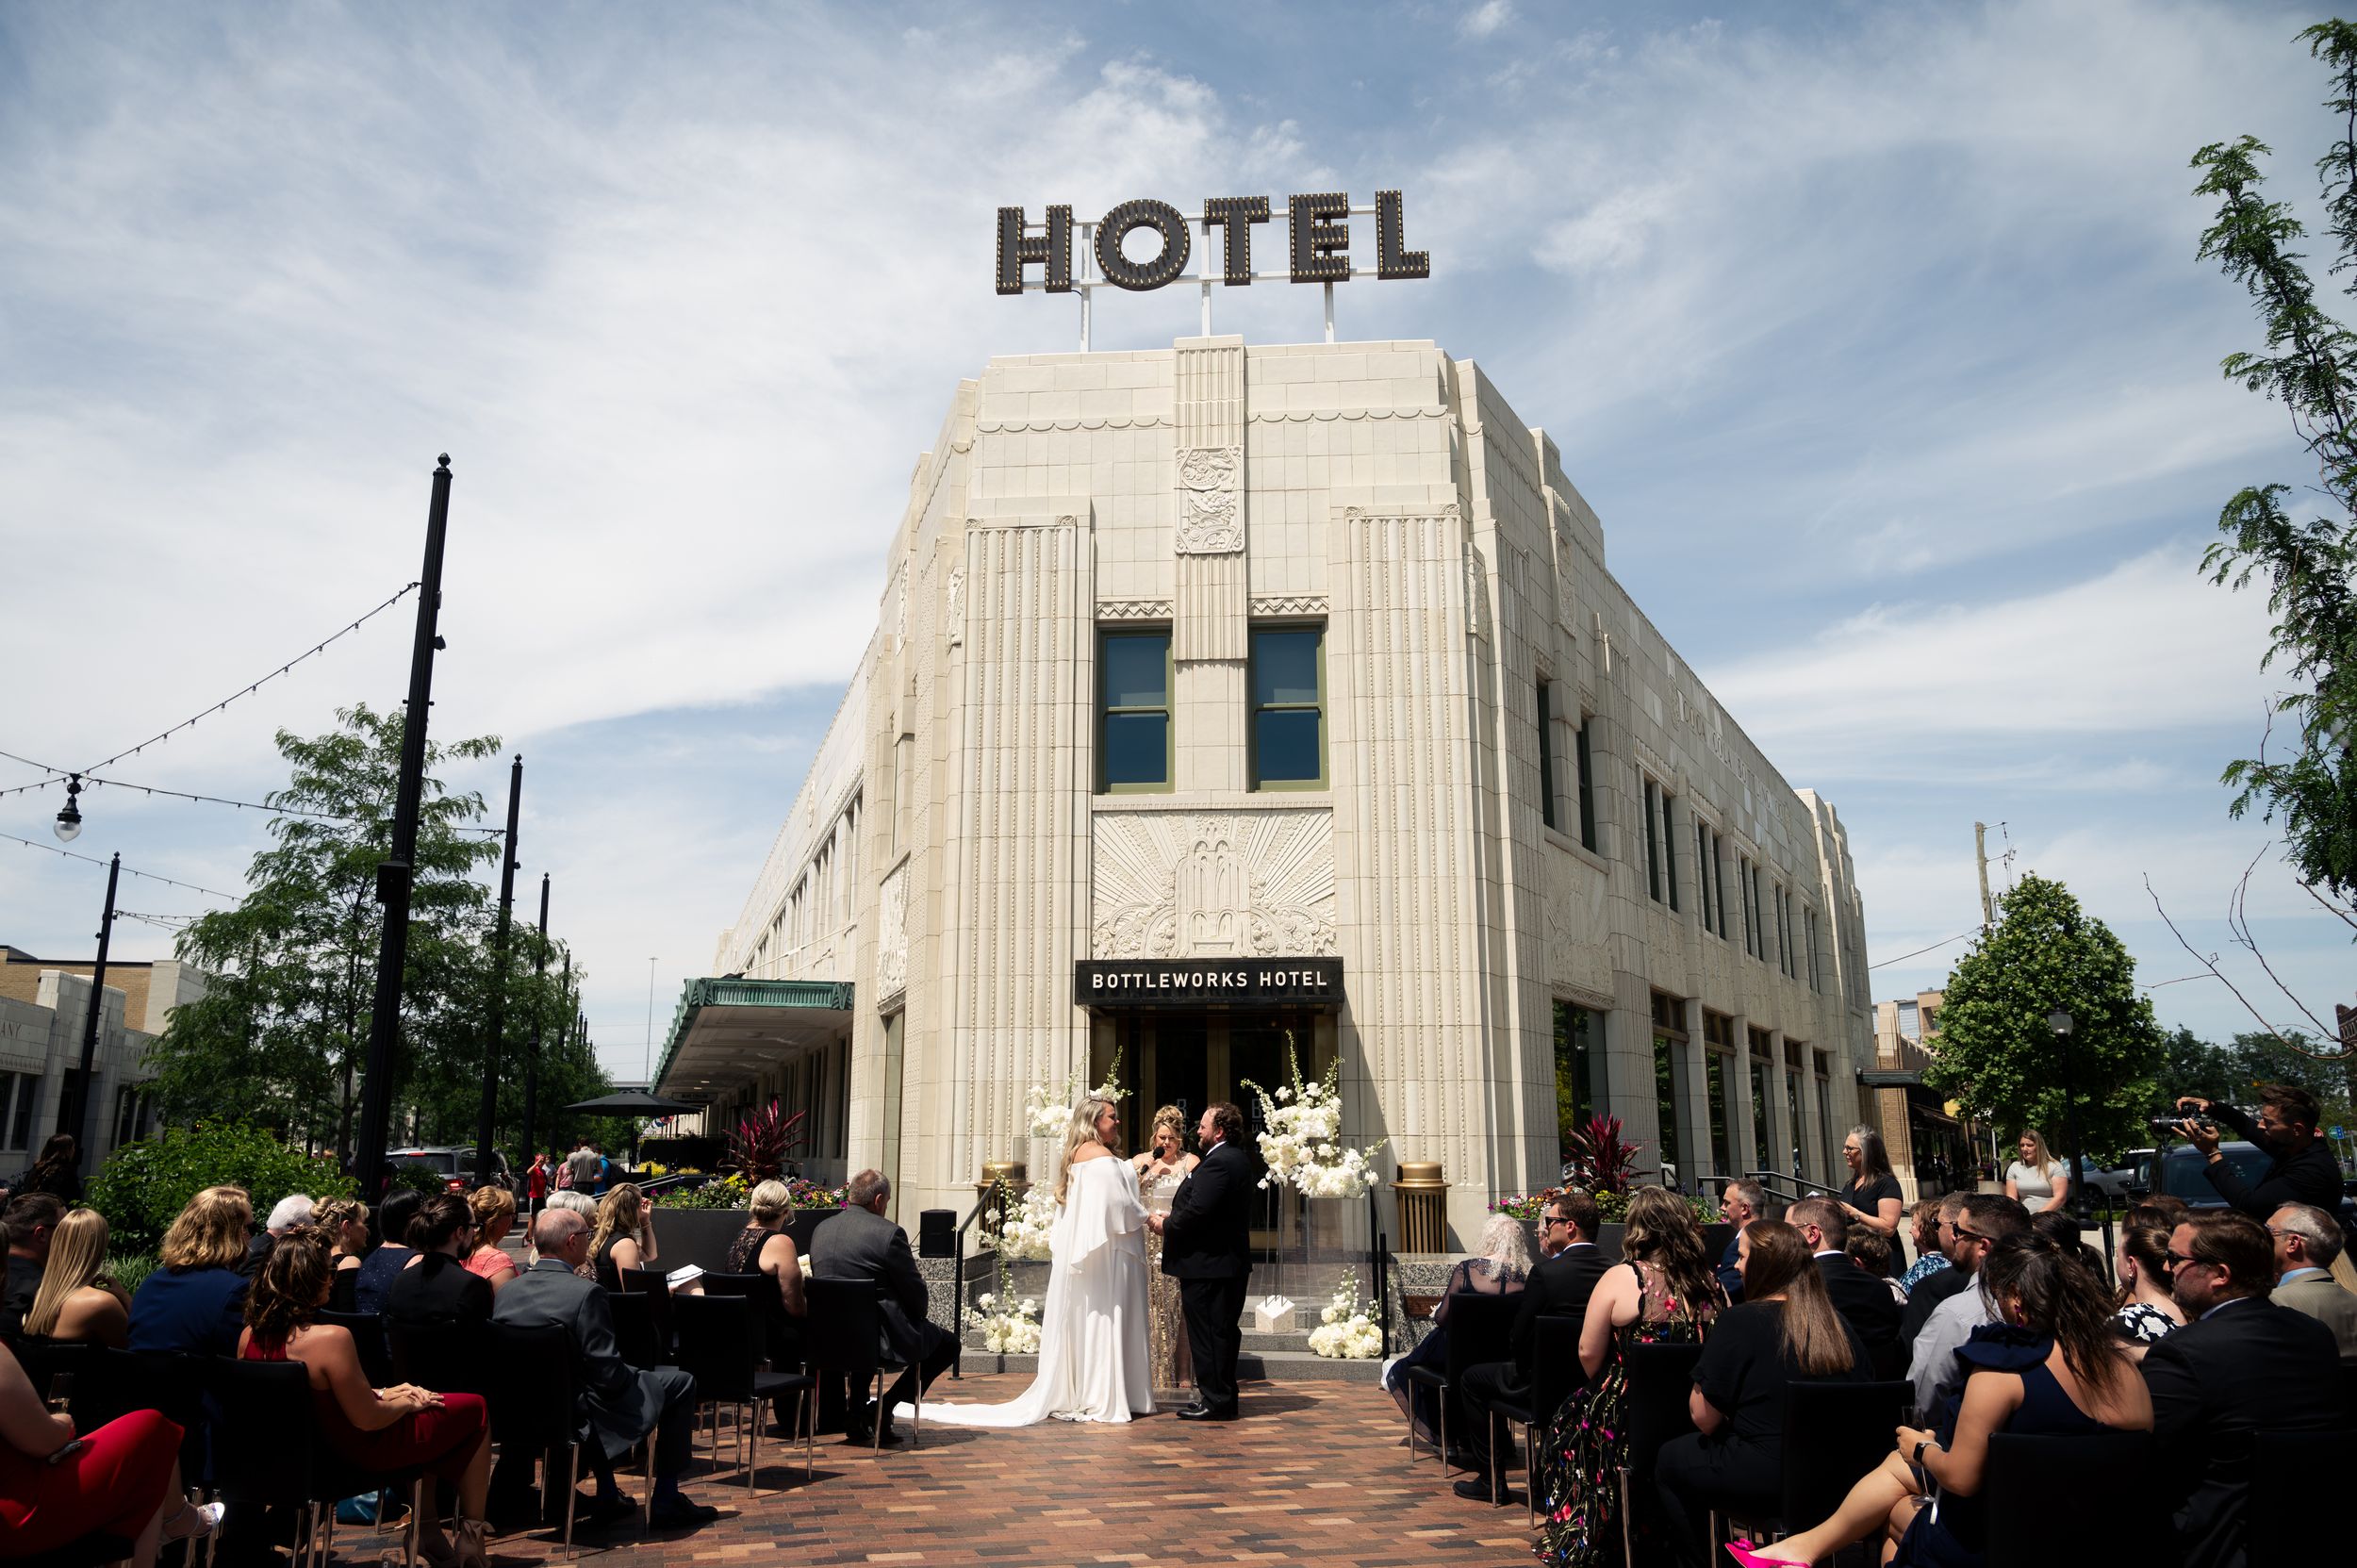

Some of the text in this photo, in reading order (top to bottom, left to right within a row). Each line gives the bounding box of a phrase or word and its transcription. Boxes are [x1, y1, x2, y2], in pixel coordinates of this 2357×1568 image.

[996, 190, 1430, 295] HOTEL
[1712, 732, 1732, 768] COLA
[1092, 971, 1327, 989] BOTTLEWORKS HOTEL
